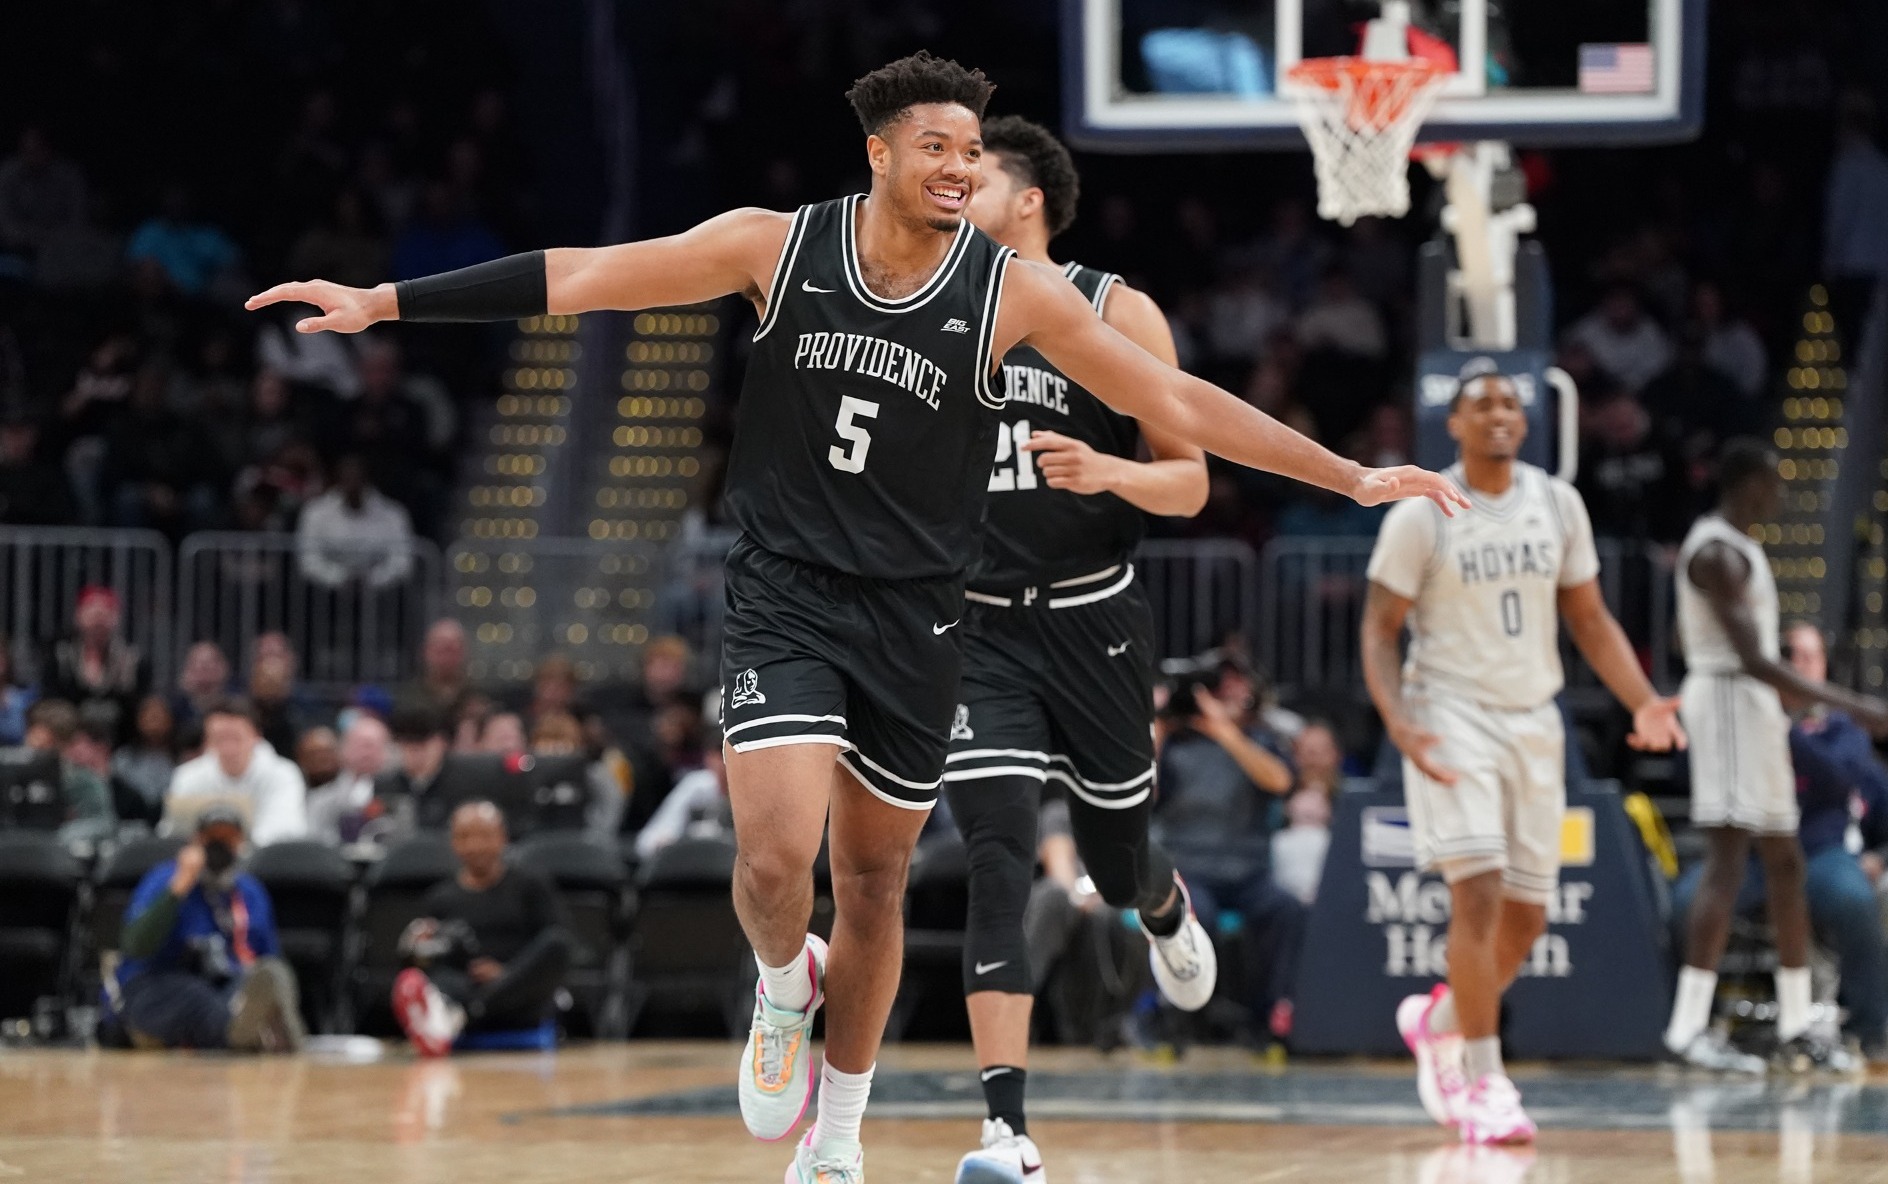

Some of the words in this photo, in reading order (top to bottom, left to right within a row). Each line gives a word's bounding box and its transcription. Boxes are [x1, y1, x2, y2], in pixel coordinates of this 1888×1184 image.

[942, 323, 971, 333] EAST
[947, 318, 968, 327] BIG
[794, 331, 948, 411] PROVIDENCE
[1003, 365, 1070, 416] DENCE
[828, 394, 880, 475] 5
[987, 419, 1038, 493] 21
[1458, 542, 1555, 585] HOYAS
[1500, 588, 1523, 637] 0
